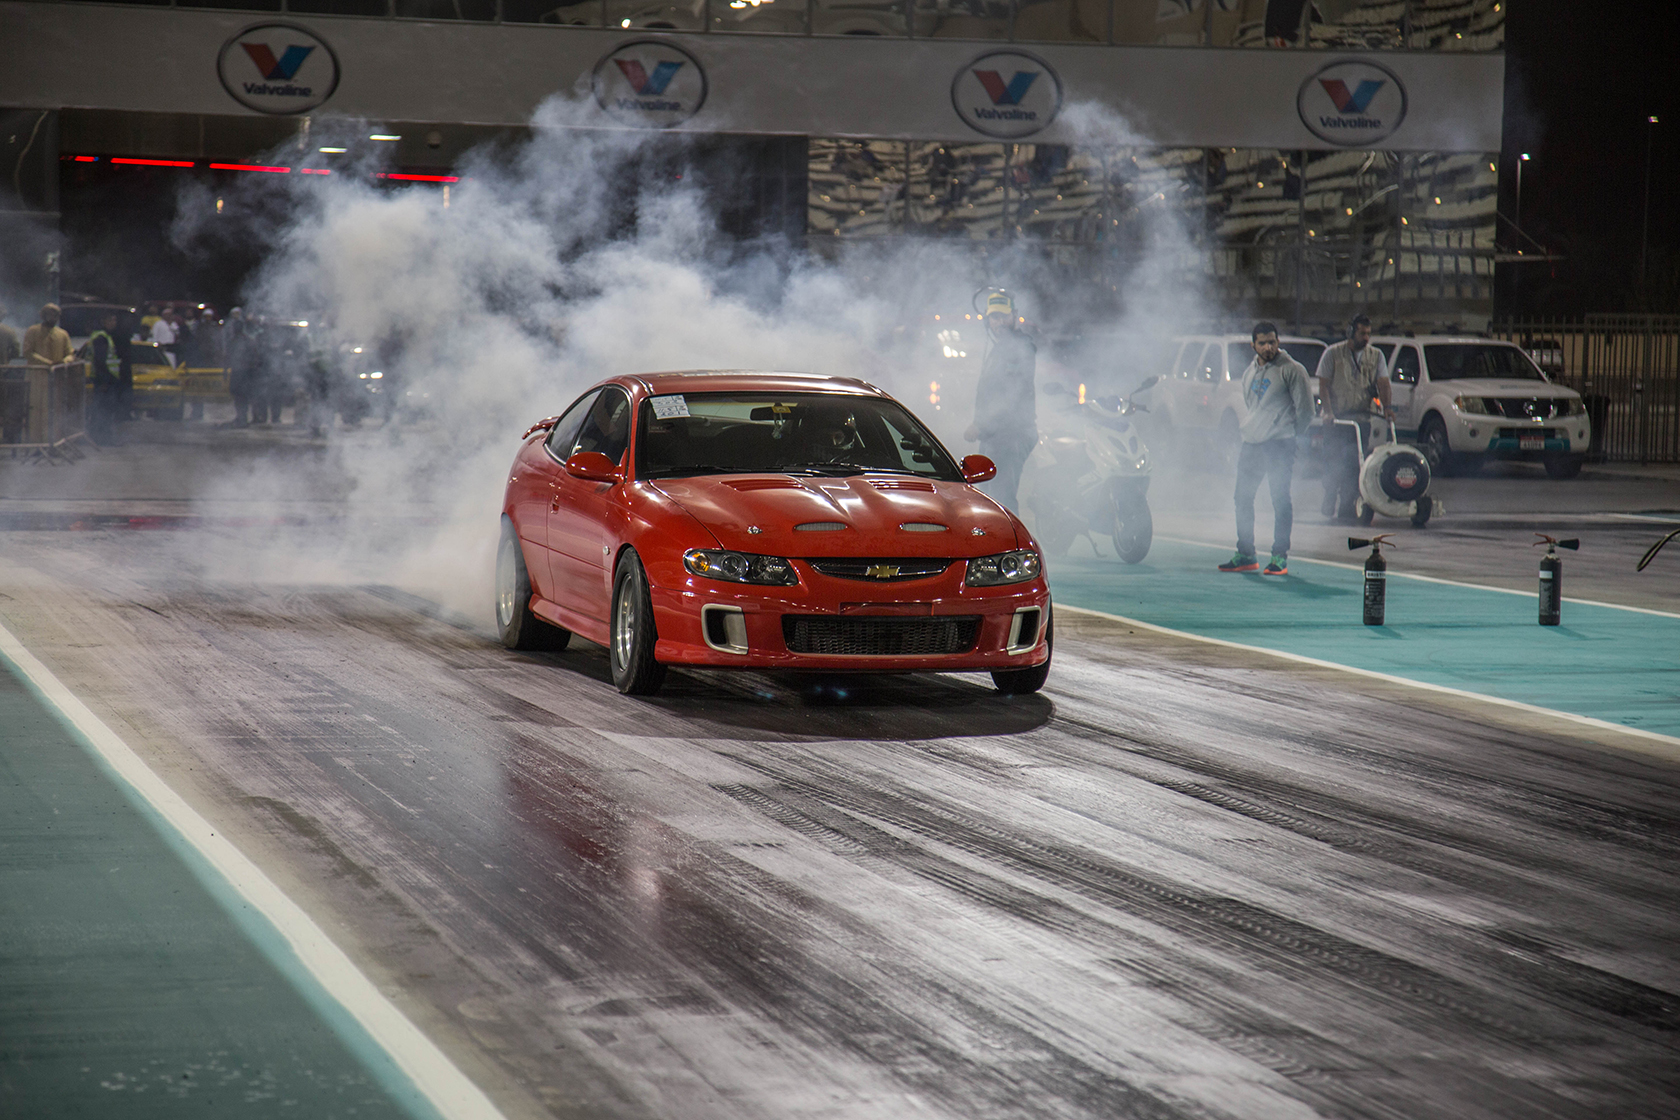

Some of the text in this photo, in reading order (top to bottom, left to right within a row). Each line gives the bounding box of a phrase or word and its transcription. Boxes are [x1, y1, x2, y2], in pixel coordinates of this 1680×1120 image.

[243, 82, 312, 97] Valvoline
[974, 107, 1037, 120] Valvoline
[1320, 116, 1381, 128] Valvoline
